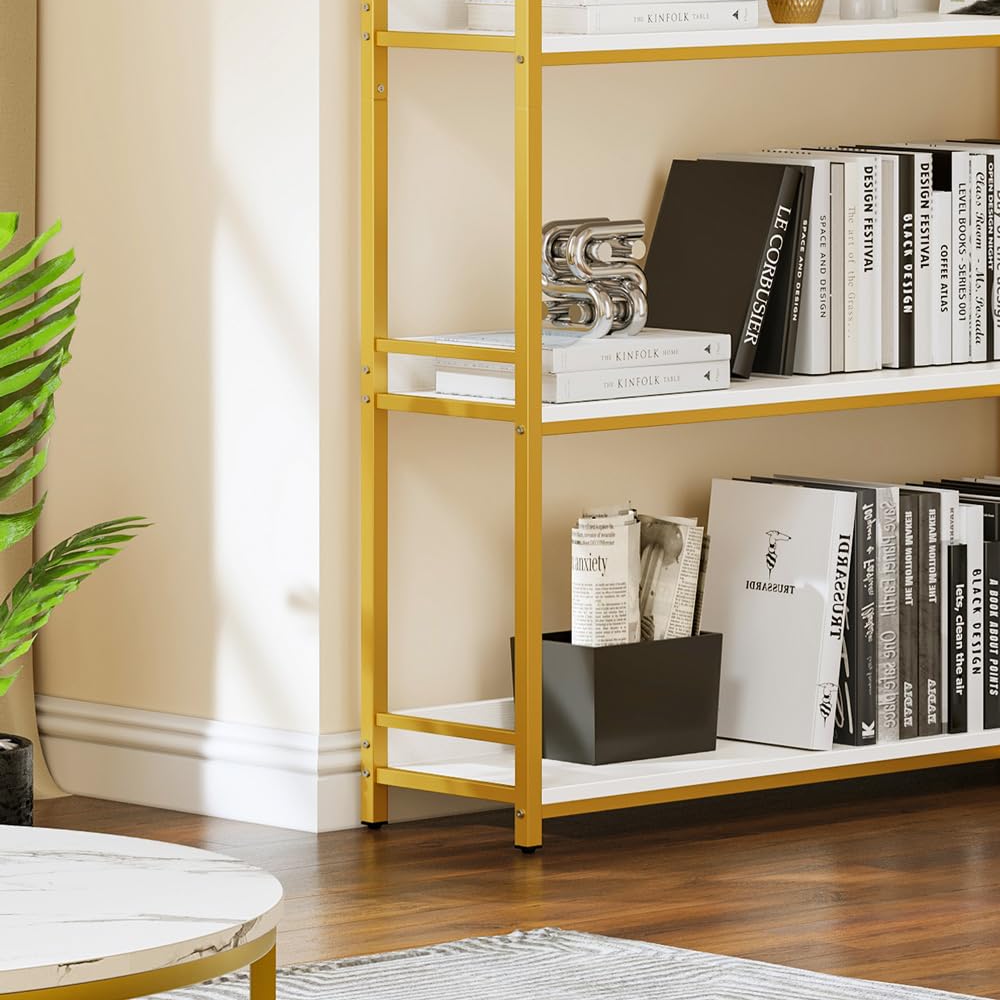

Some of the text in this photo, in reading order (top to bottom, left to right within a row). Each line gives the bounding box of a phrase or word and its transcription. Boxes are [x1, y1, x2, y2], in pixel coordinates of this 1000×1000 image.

[800, 220, 808, 252] SPACE
[864, 166, 874, 272] DESIGN FESTIVAL
[903, 214, 913, 313] BLACK DESIGN
[920, 163, 930, 269] DESIGN FESTIVAL
[958, 183, 966, 321] LEVEL BOOKS SERIES 001
[744, 205, 792, 346] LE CORBUSIER
[792, 282, 802, 322] DESIGN
[940, 244, 948, 312] COFFEE ATLAS
[616, 348, 660, 362] KINFOLK
[618, 375, 660, 388] KINFOLK
[574, 552, 608, 576] anxiety
[954, 584, 965, 696] lets, clean the air
[972, 568, 982, 675] BLACK DESIGN
[990, 578, 999, 696] A BOOK ABOUT POINTS
